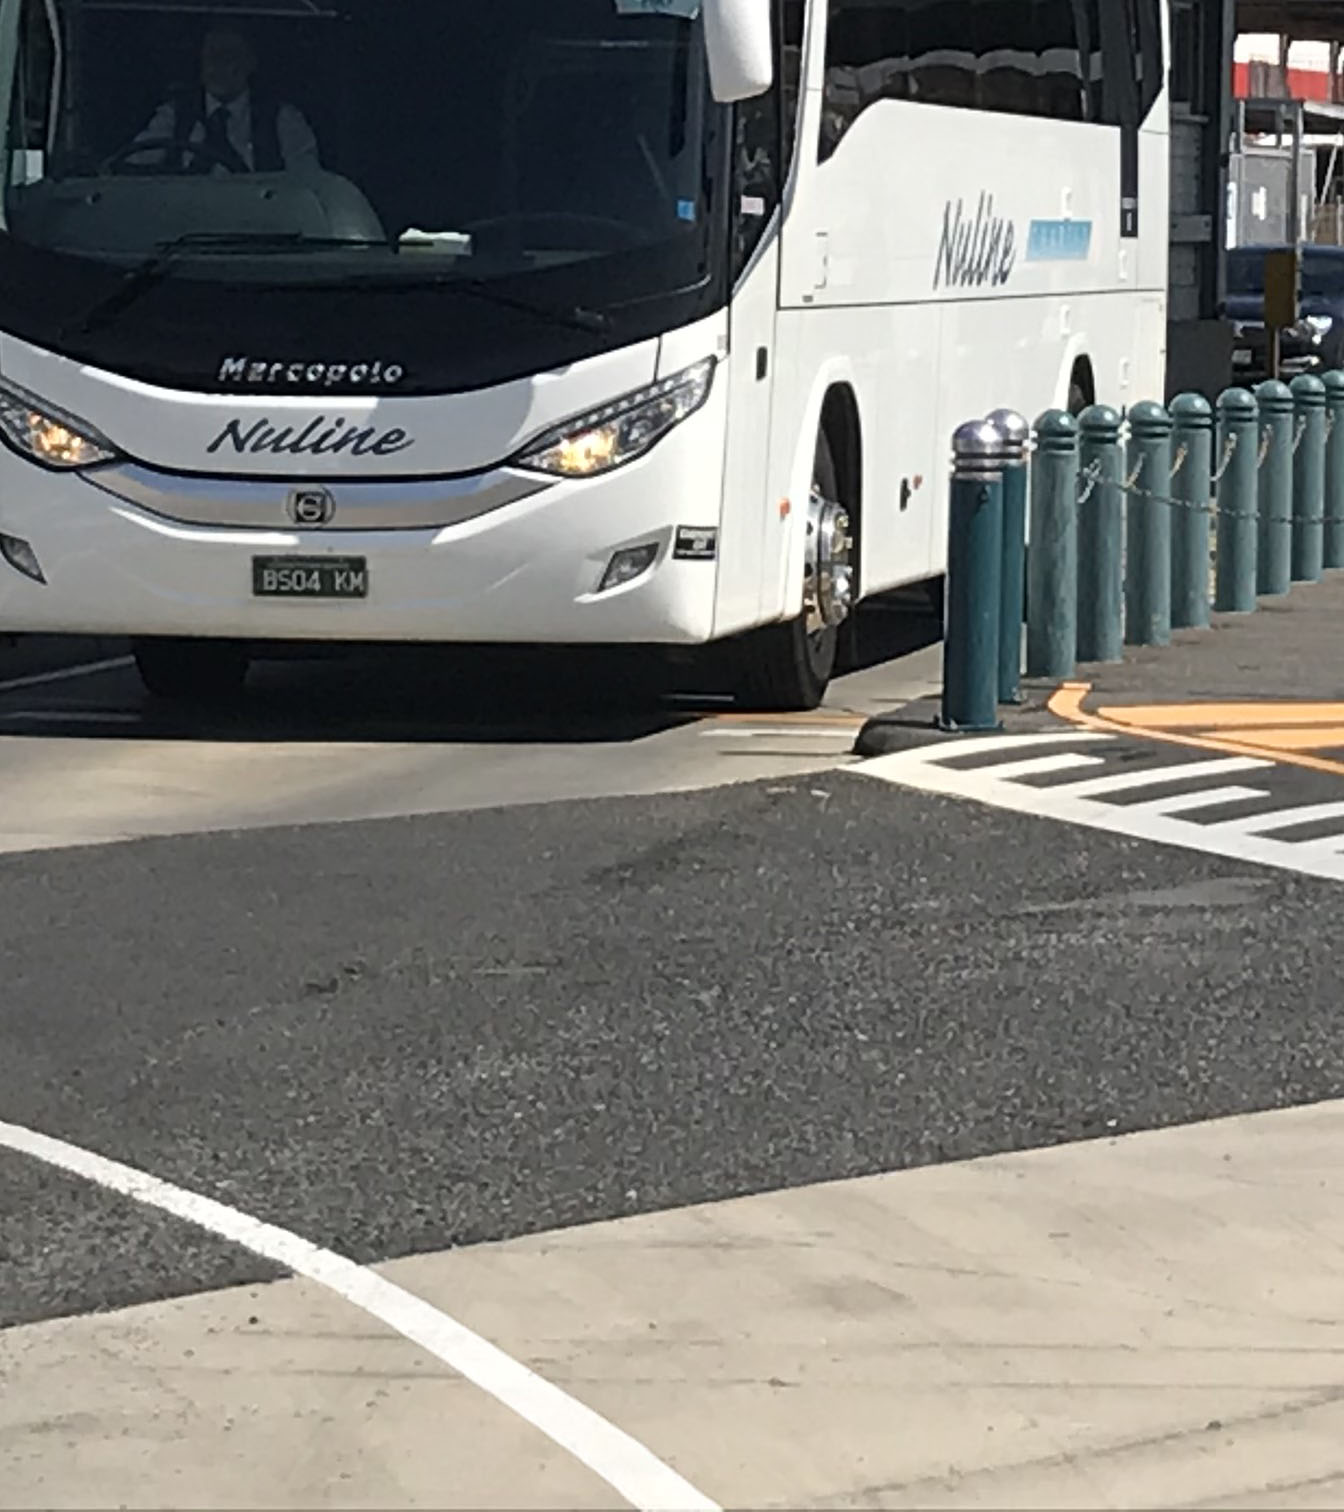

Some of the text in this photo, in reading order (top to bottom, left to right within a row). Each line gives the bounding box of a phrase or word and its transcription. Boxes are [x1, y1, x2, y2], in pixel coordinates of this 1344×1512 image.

[932, 190, 1017, 290] Nuline
[218, 357, 403, 387] Marcopolo
[206, 415, 415, 456] Nuline
